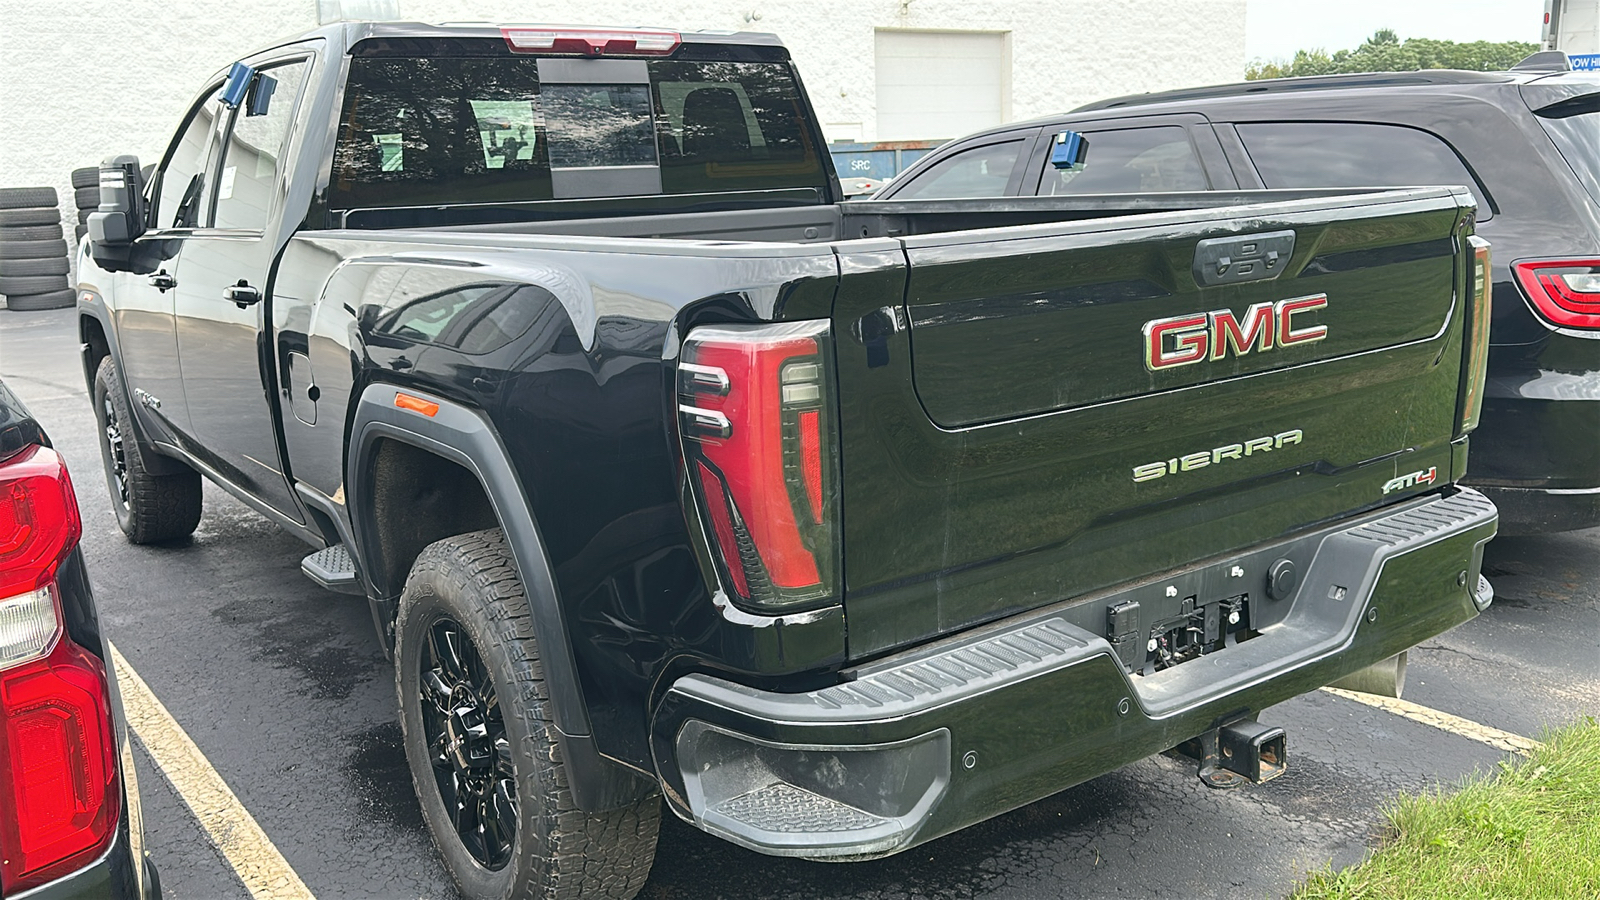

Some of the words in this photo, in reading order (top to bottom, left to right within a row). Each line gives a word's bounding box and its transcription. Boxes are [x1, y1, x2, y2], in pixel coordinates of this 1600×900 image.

[851, 160, 871, 171] SRC
[1141, 293, 1328, 373] GMC
[1132, 429, 1303, 483] SIERRA
[1381, 466, 1437, 494] AT4
